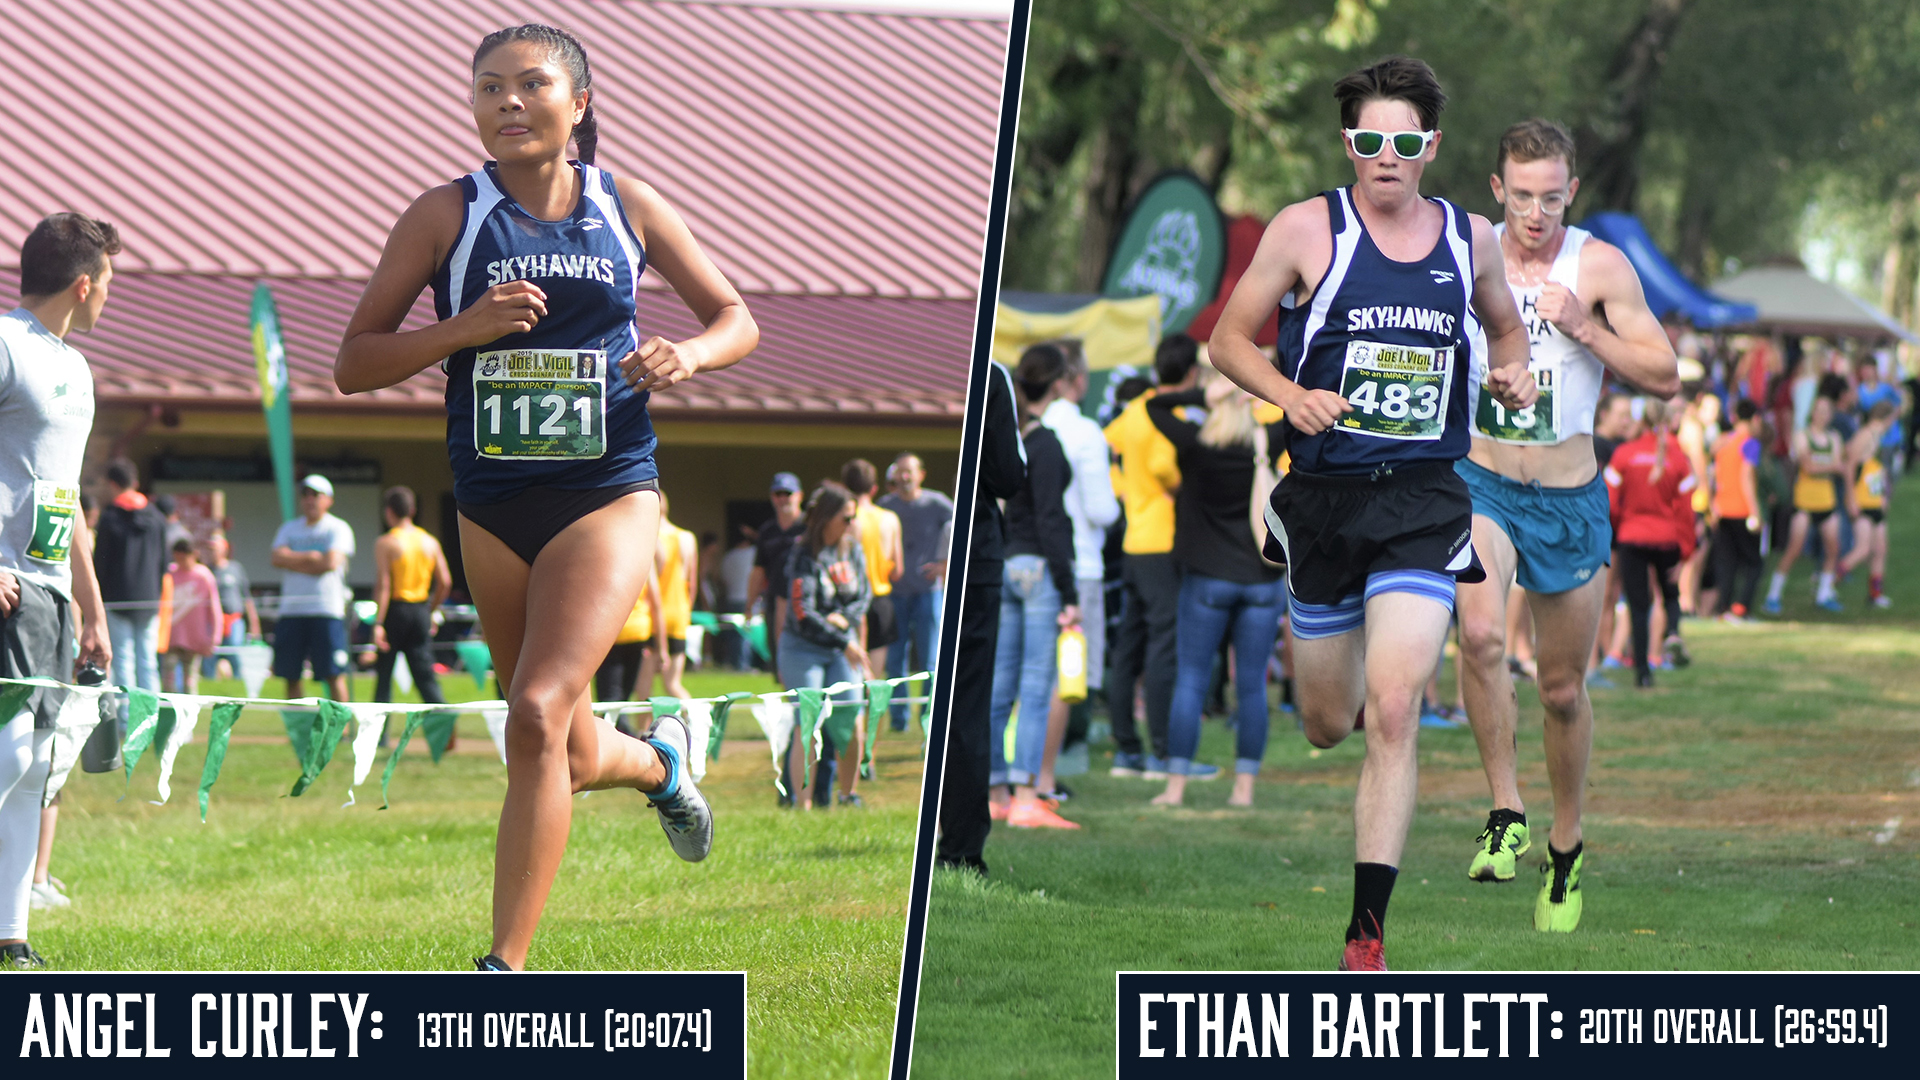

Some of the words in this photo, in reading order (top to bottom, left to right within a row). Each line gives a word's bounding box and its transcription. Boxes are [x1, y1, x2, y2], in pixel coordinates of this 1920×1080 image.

[487, 254, 615, 287] SKYHAWKS
[1347, 305, 1456, 337] SKYHAWKS
[507, 353, 532, 371] JOE
[541, 353, 576, 372] VIGIL
[1377, 349, 1398, 362] JOE
[1405, 349, 1432, 366] VIGIL
[509, 371, 528, 379] CROSS
[529, 371, 556, 379] COUNTRY
[519, 381, 552, 389] IMPACT
[1383, 371, 1413, 381] IMPACT
[1348, 380, 1440, 420] 483
[483, 394, 592, 436] 1121
[48, 516, 73, 548] 72
